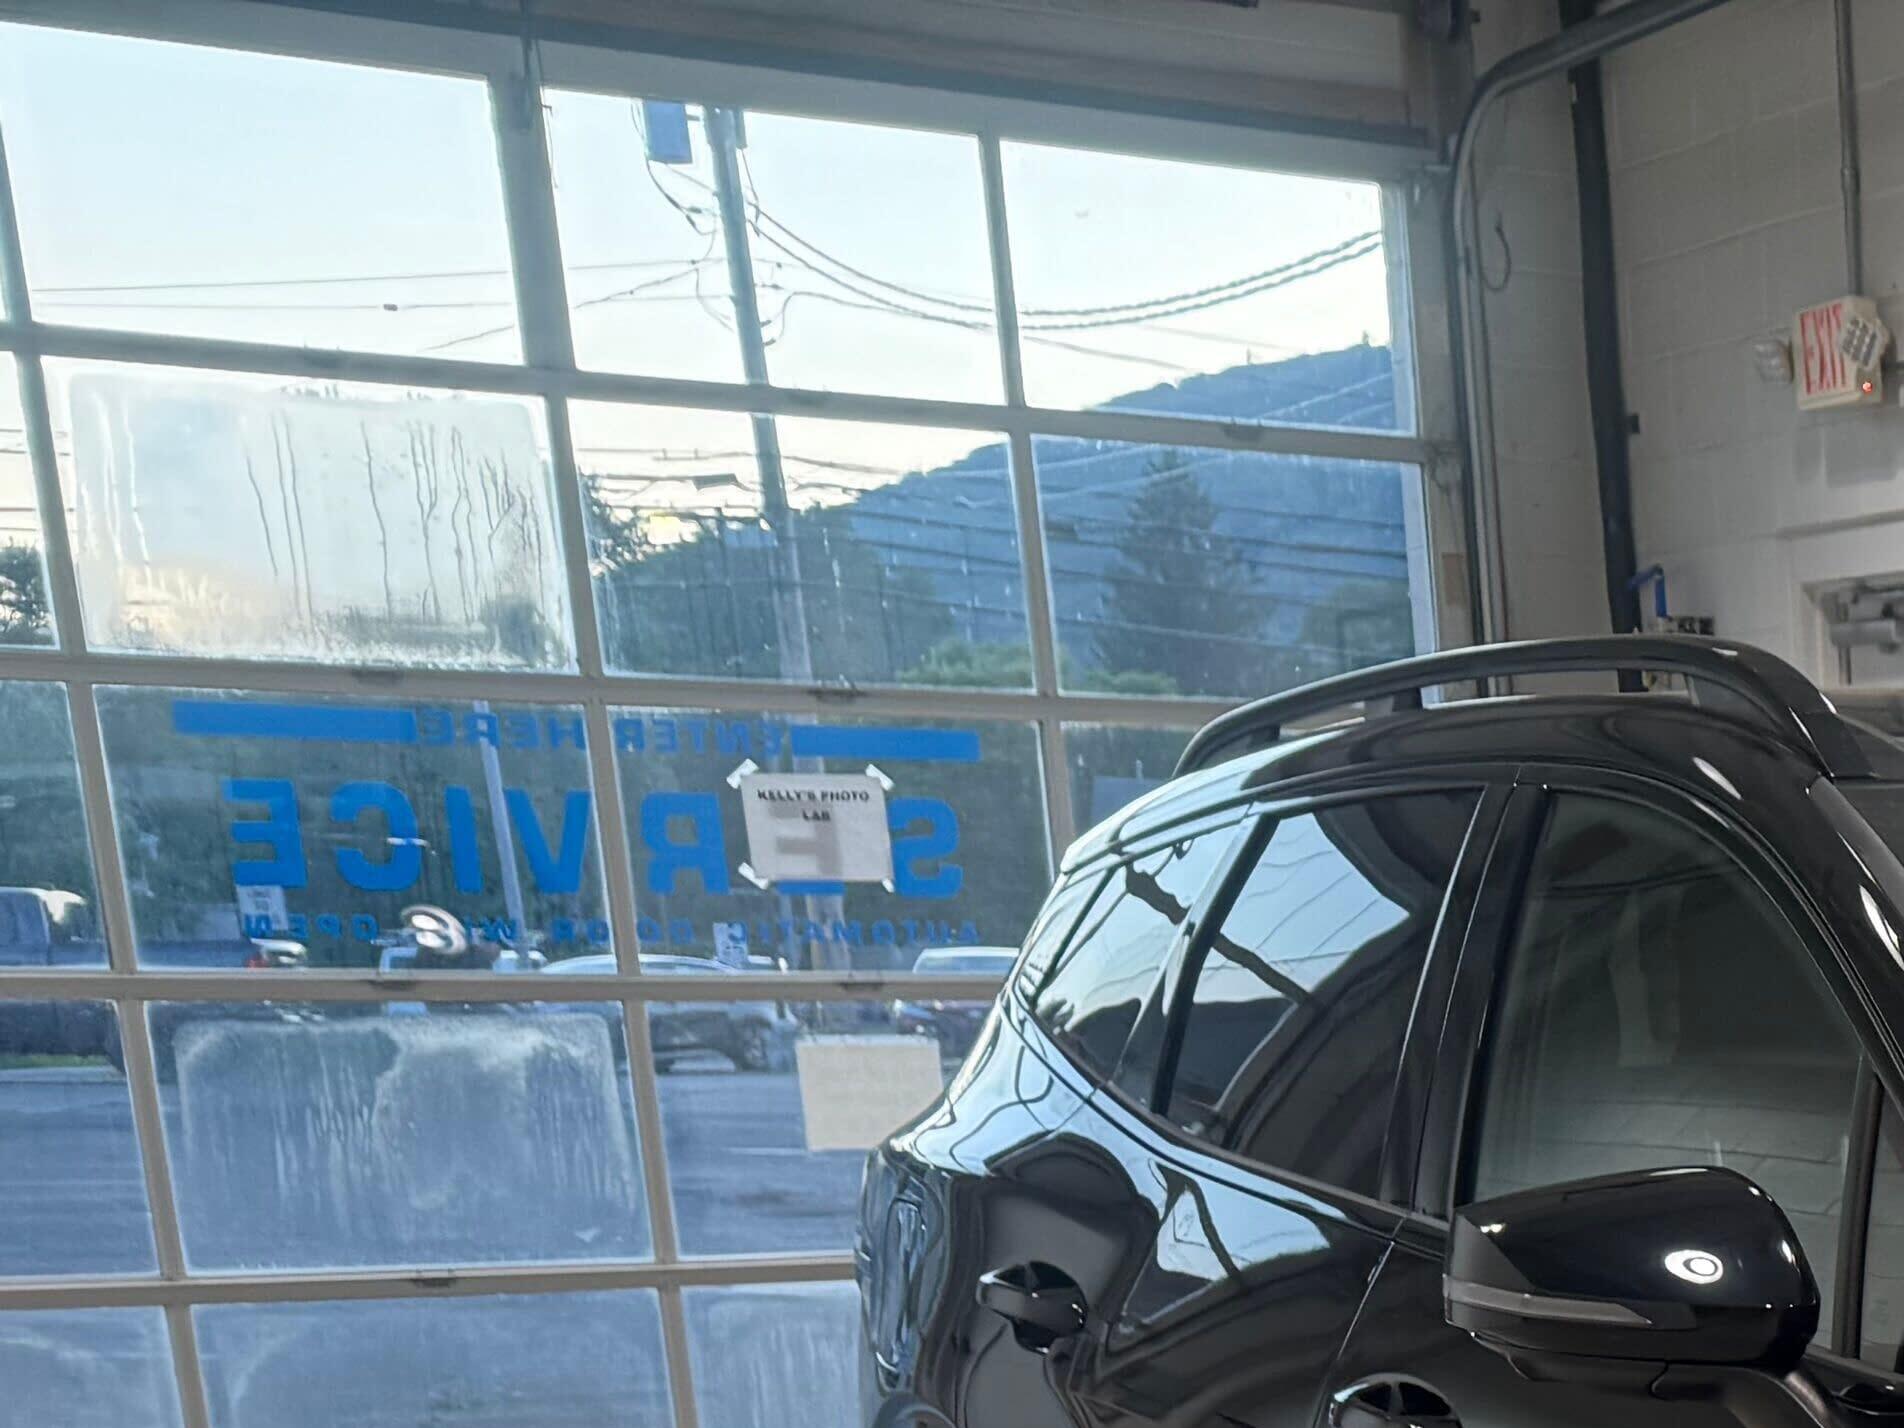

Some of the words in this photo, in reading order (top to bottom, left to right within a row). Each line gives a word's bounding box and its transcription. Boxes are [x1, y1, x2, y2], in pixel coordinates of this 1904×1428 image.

[1800, 303, 1846, 395] EXIT
[821, 790, 870, 803] PHOTO
[802, 810, 831, 822] LAB
